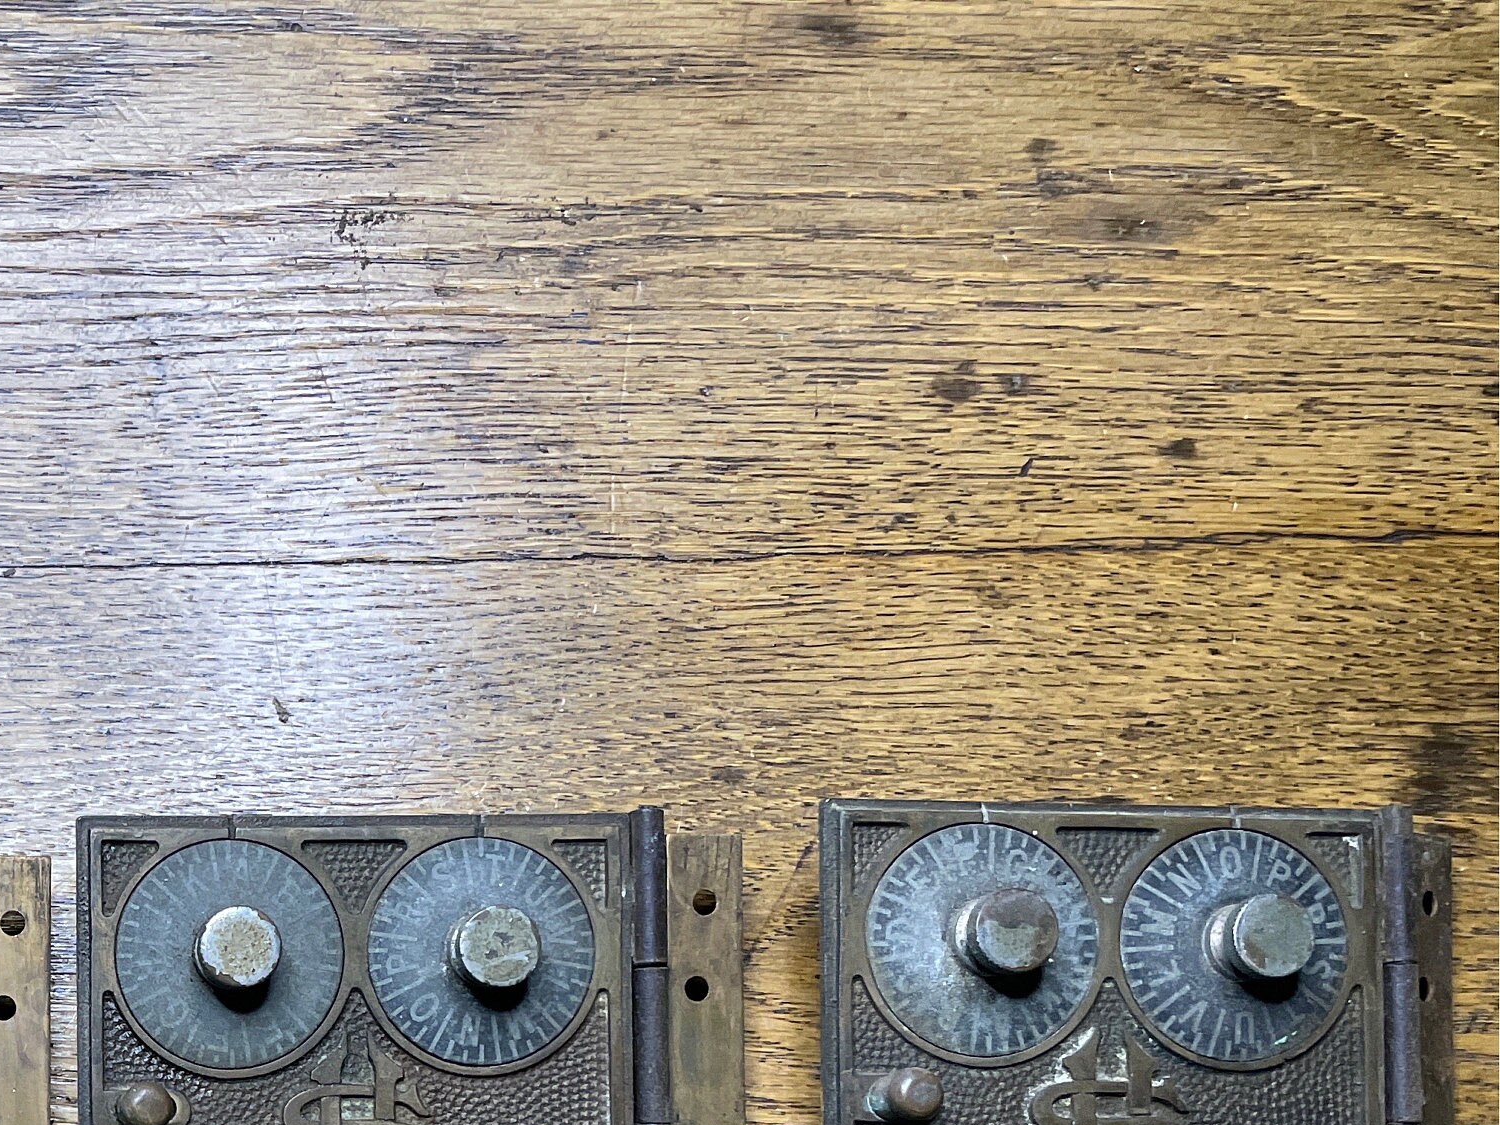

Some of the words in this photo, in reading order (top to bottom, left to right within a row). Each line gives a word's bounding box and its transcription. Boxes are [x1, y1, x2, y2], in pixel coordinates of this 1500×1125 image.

[431, 861, 457, 892] S
[485, 853, 506, 885] T
[1166, 863, 1203, 897] N
[1266, 859, 1292, 888] P
[524, 875, 555, 906] U
[1139, 907, 1178, 936] M
[386, 954, 420, 975] P
[410, 992, 440, 1023] O
[1235, 1011, 1255, 1045] U
